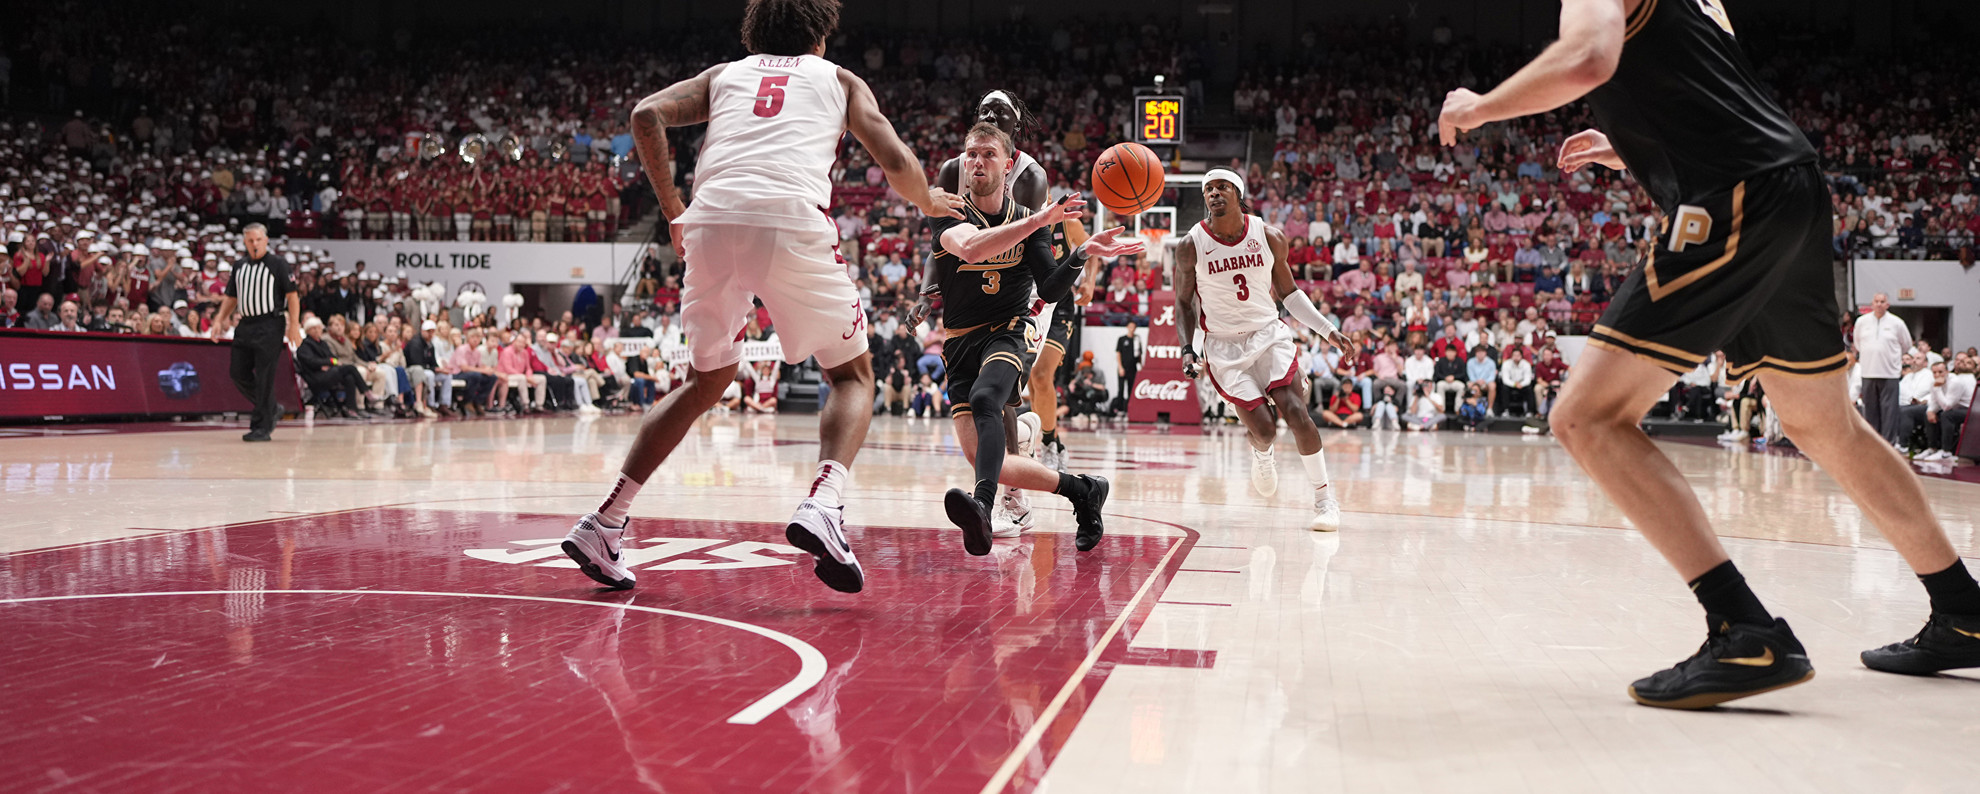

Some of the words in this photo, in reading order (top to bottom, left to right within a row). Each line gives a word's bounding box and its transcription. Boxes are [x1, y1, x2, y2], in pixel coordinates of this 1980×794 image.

[758, 57, 805, 68] ALLEN
[752, 75, 790, 118] 5
[1145, 100, 1179, 115] 16:04
[1144, 114, 1175, 139] 20
[1667, 204, 1713, 253] P
[395, 253, 444, 268] ROLL
[450, 254, 491, 269] TIDE
[1207, 254, 1265, 275] ALABAMA
[981, 270, 1001, 295] 3
[1232, 273, 1250, 302] 3
[842, 297, 865, 340] A
[1153, 305, 1175, 326] A
[1147, 345, 1181, 359] YETI
